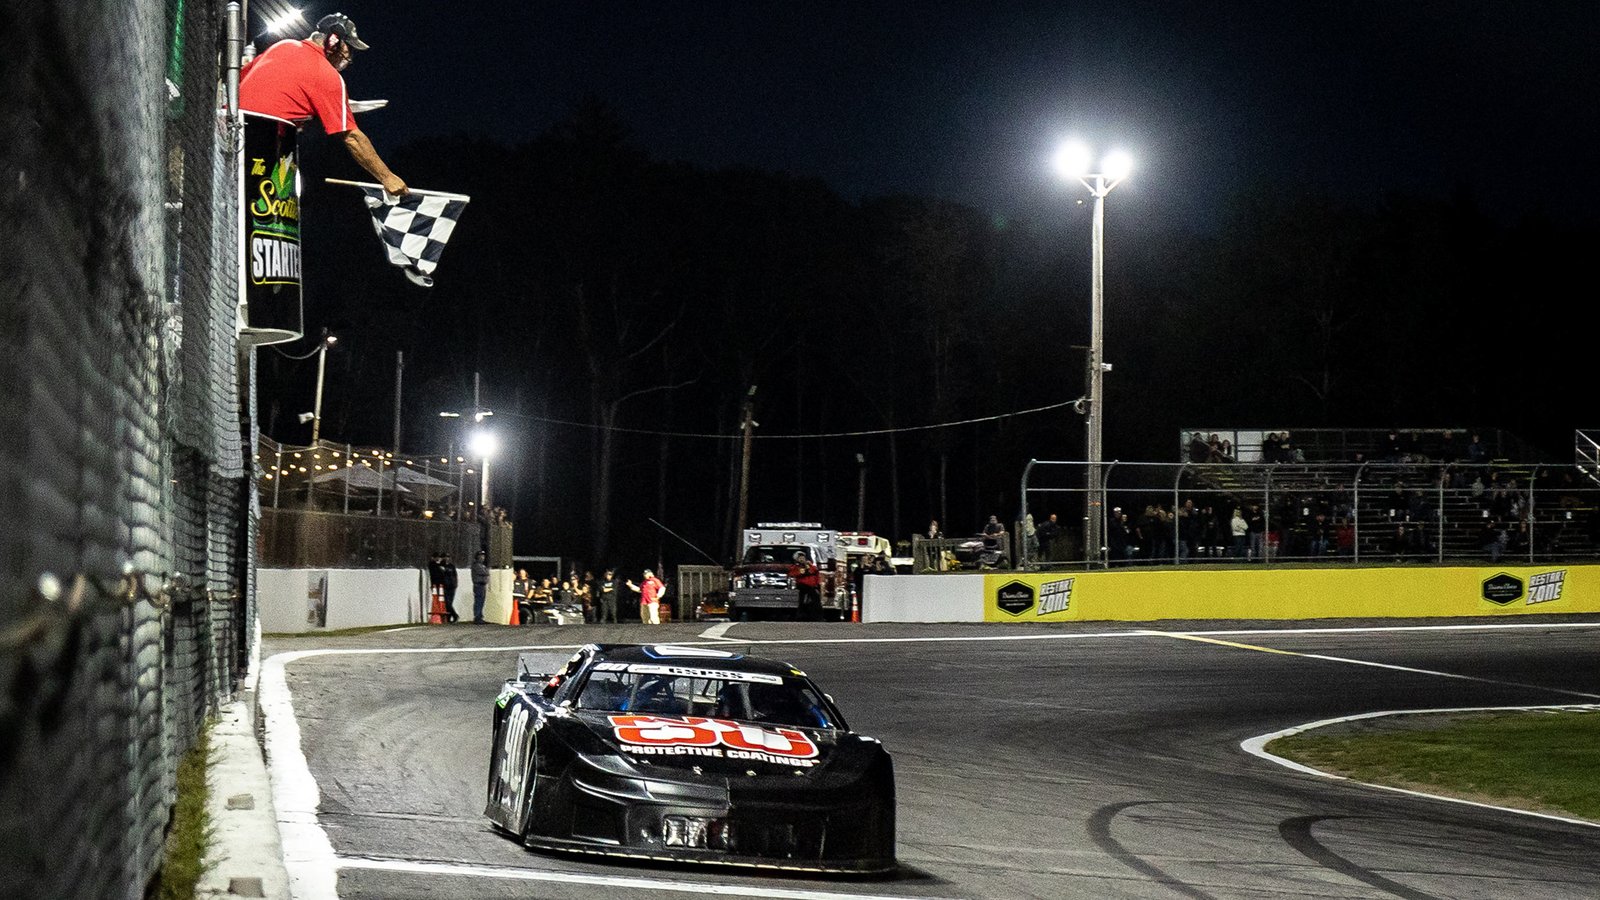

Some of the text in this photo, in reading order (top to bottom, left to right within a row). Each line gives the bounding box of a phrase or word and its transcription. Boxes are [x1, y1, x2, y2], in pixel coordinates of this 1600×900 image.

[251, 158, 266, 175] The
[253, 237, 300, 278] STARTE
[1040, 578, 1075, 597] RESTART
[1529, 569, 1567, 588] RESTART
[1037, 591, 1071, 616] ZONE
[1526, 581, 1563, 605] ZONE
[620, 744, 814, 767] PROTECTIVE COATINGS
